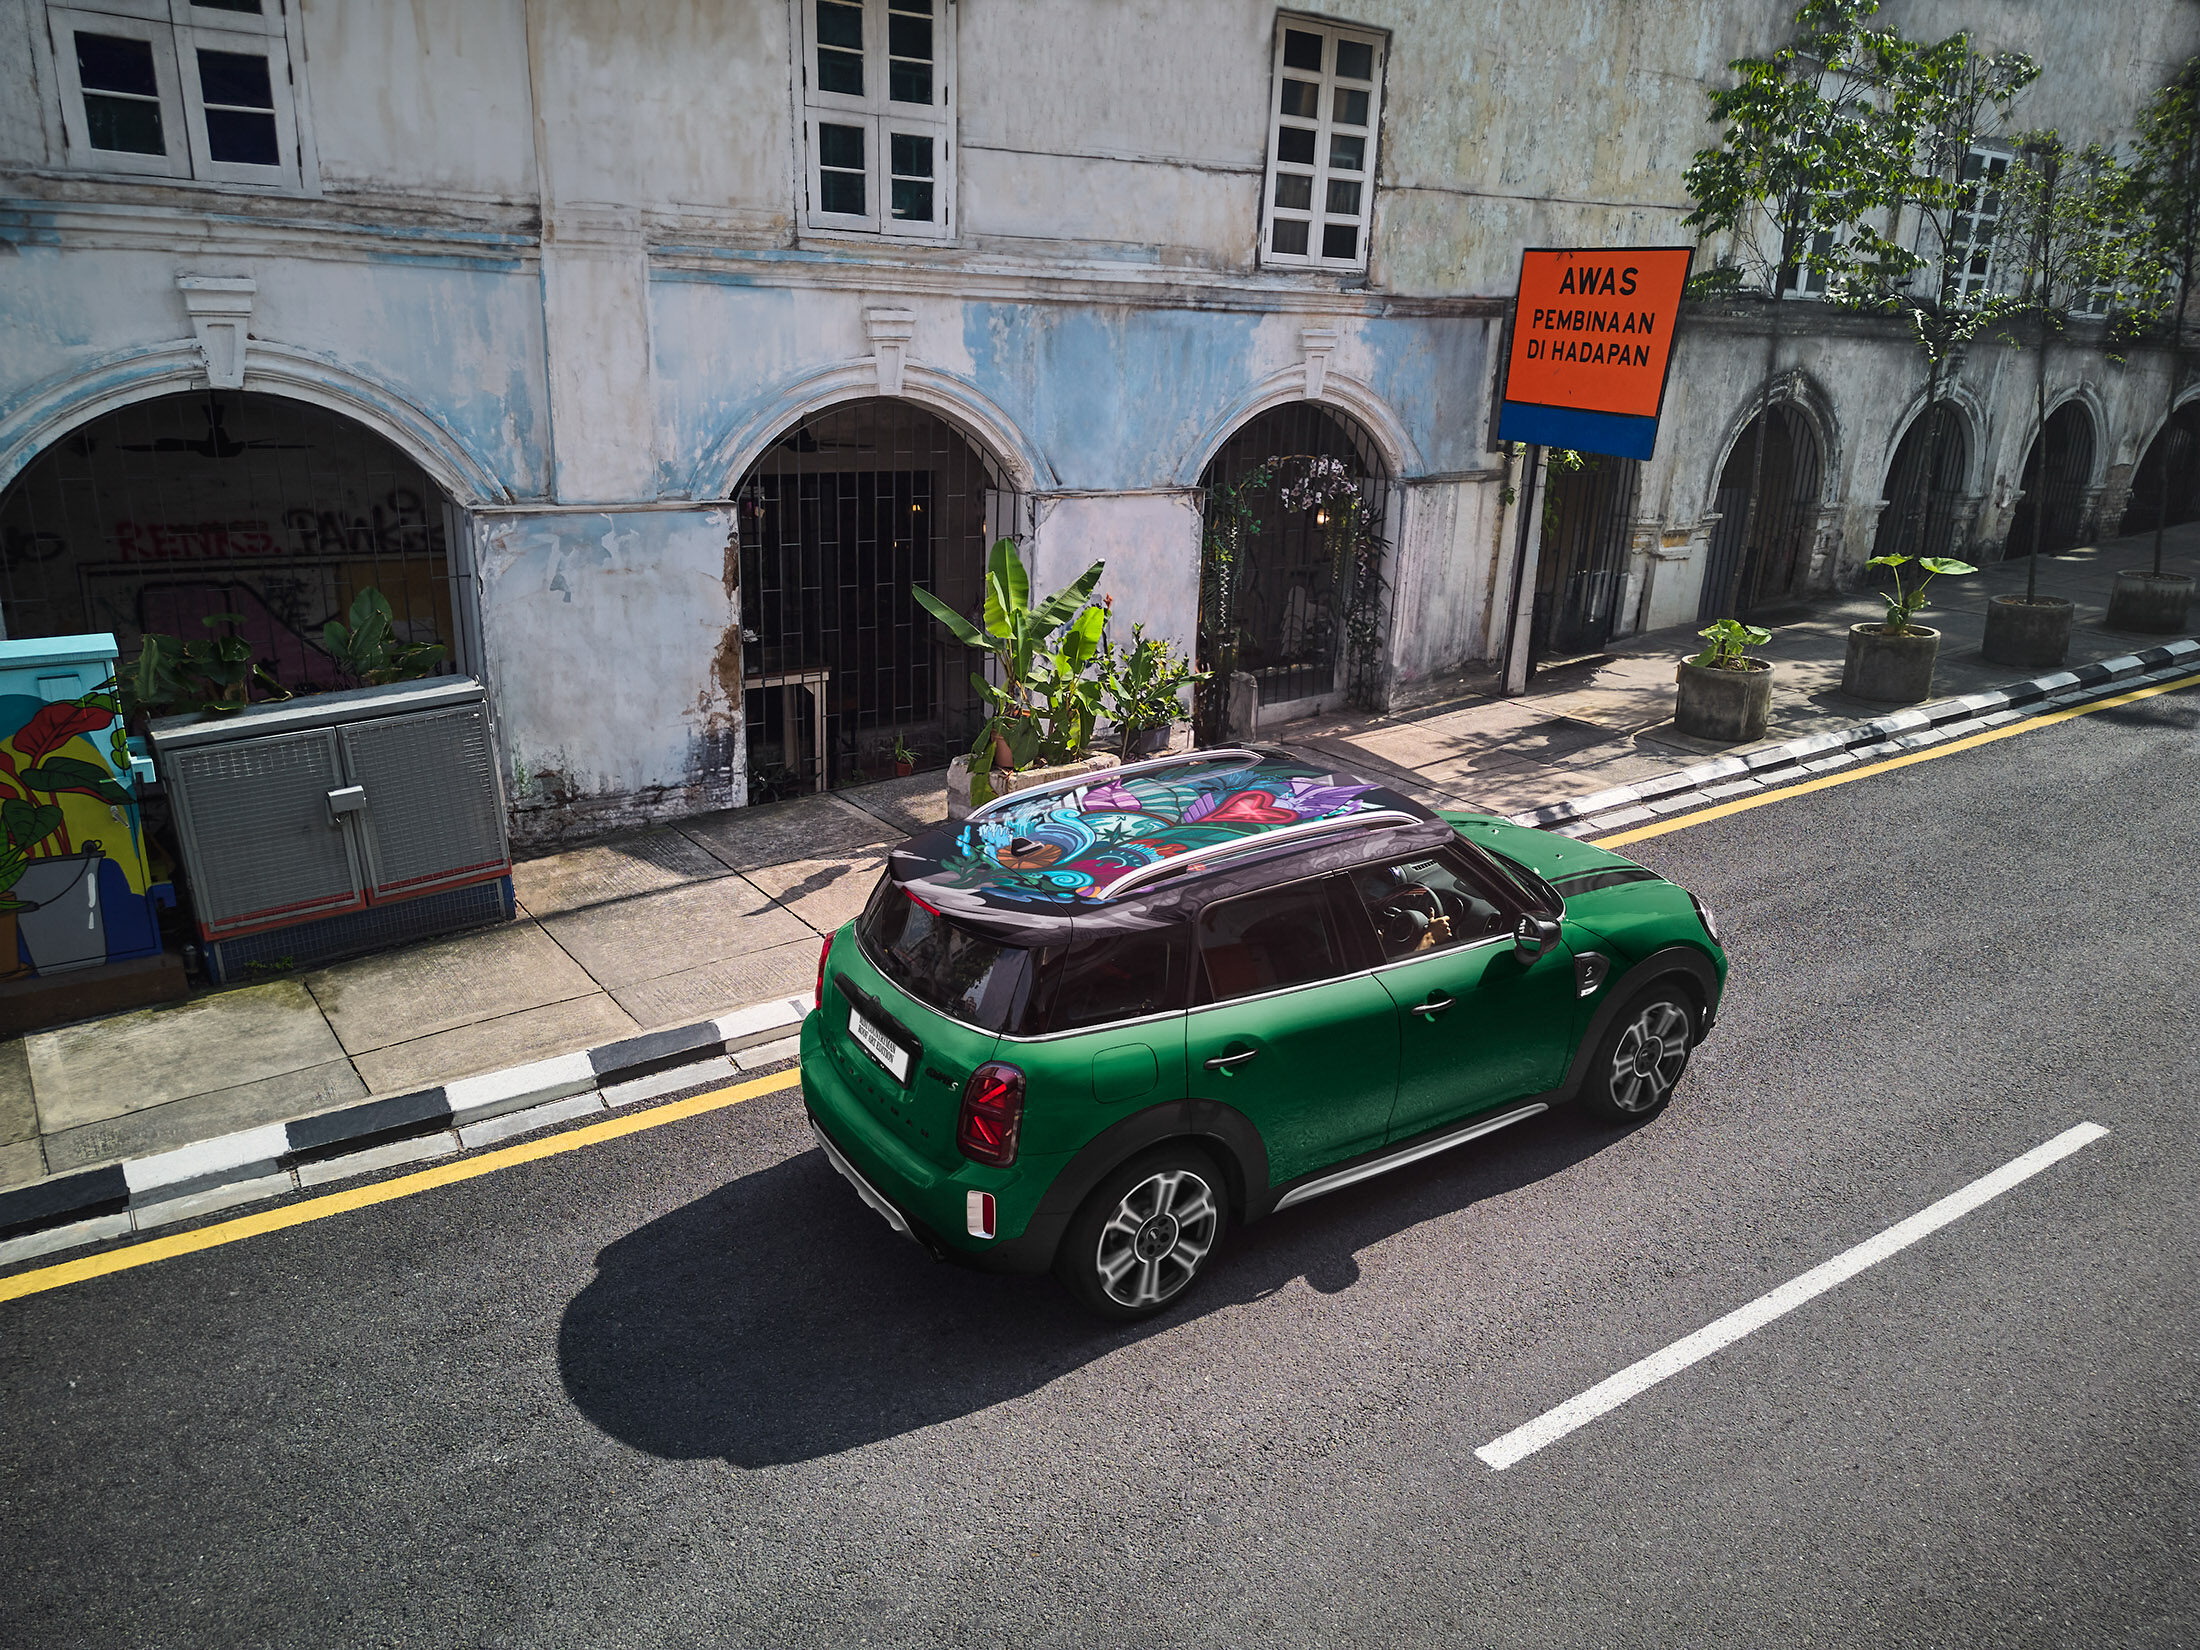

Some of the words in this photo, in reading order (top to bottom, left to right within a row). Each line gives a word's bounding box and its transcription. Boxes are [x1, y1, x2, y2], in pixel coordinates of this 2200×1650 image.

[1559, 267, 1639, 296] AWAS
[1532, 308, 1655, 335] PEMBINAAN
[1527, 339, 1546, 360] DI
[1551, 340, 1650, 367] HADAPAN
[1585, 966, 1592, 977] S
